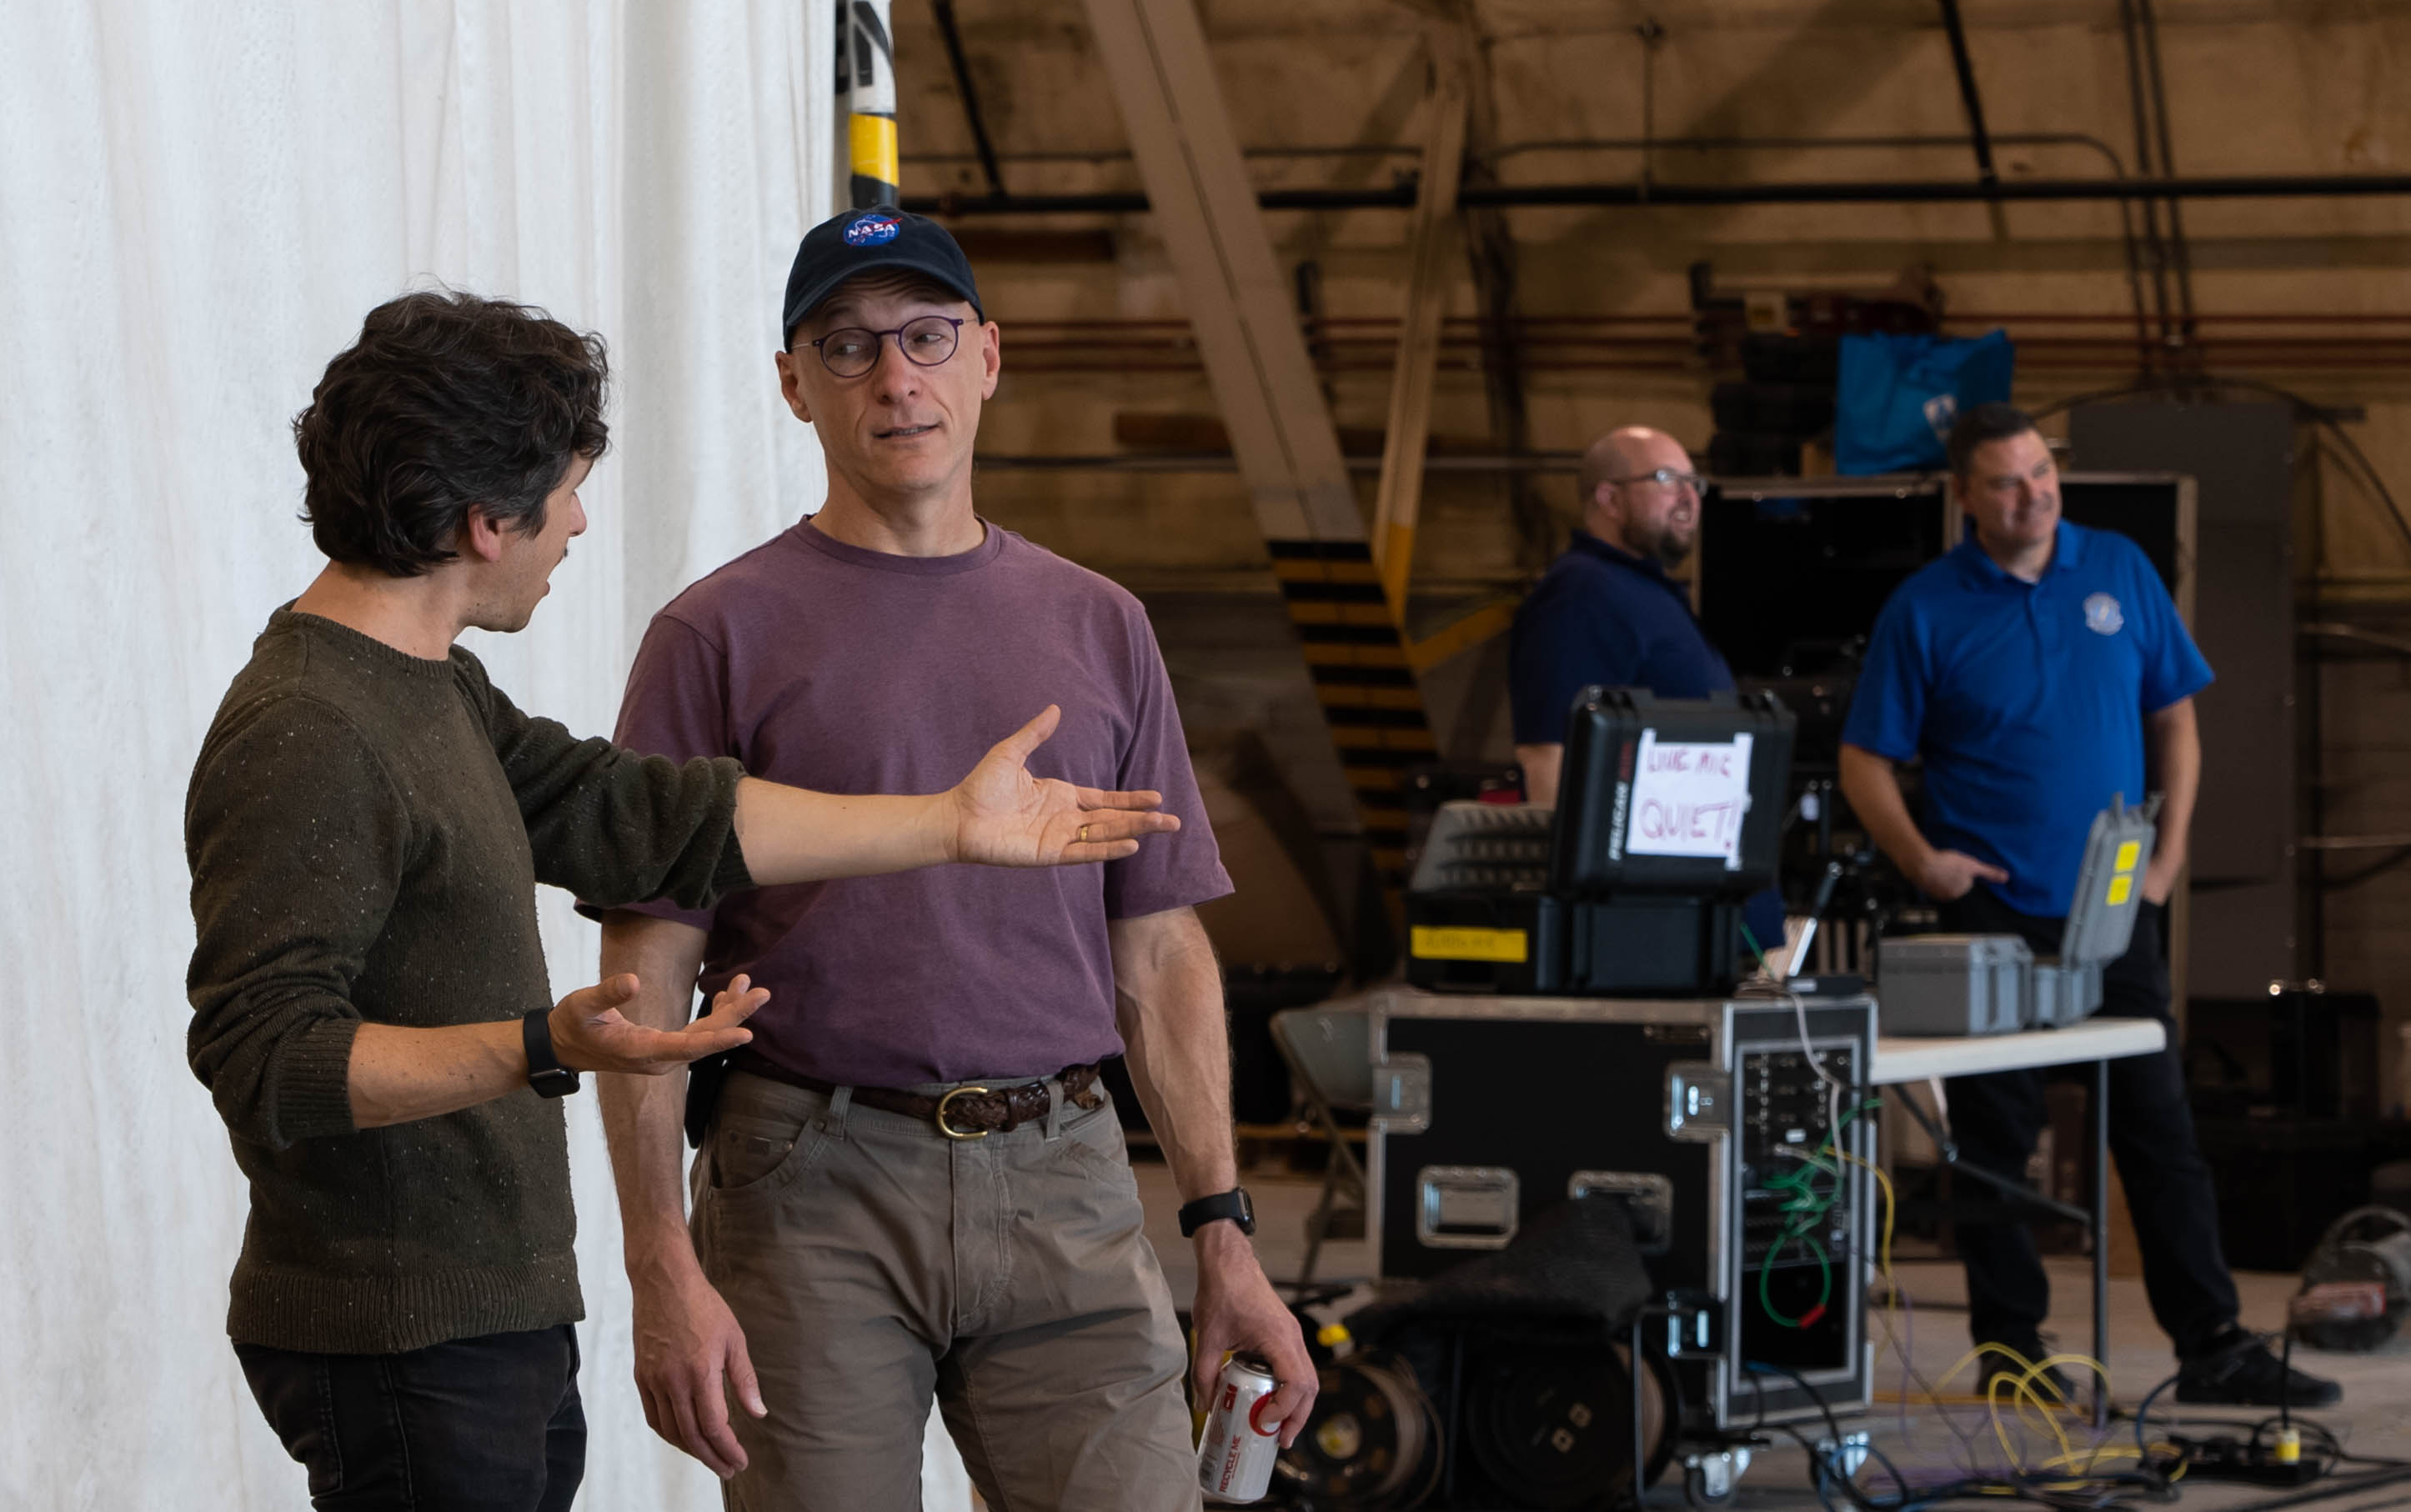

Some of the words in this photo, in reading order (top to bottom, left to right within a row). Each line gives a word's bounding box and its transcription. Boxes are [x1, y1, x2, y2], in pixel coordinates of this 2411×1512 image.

[848, 223, 895, 238] NASA
[1219, 1452, 1236, 1493] RECYCLE
[1231, 1434, 1241, 1451] ME
